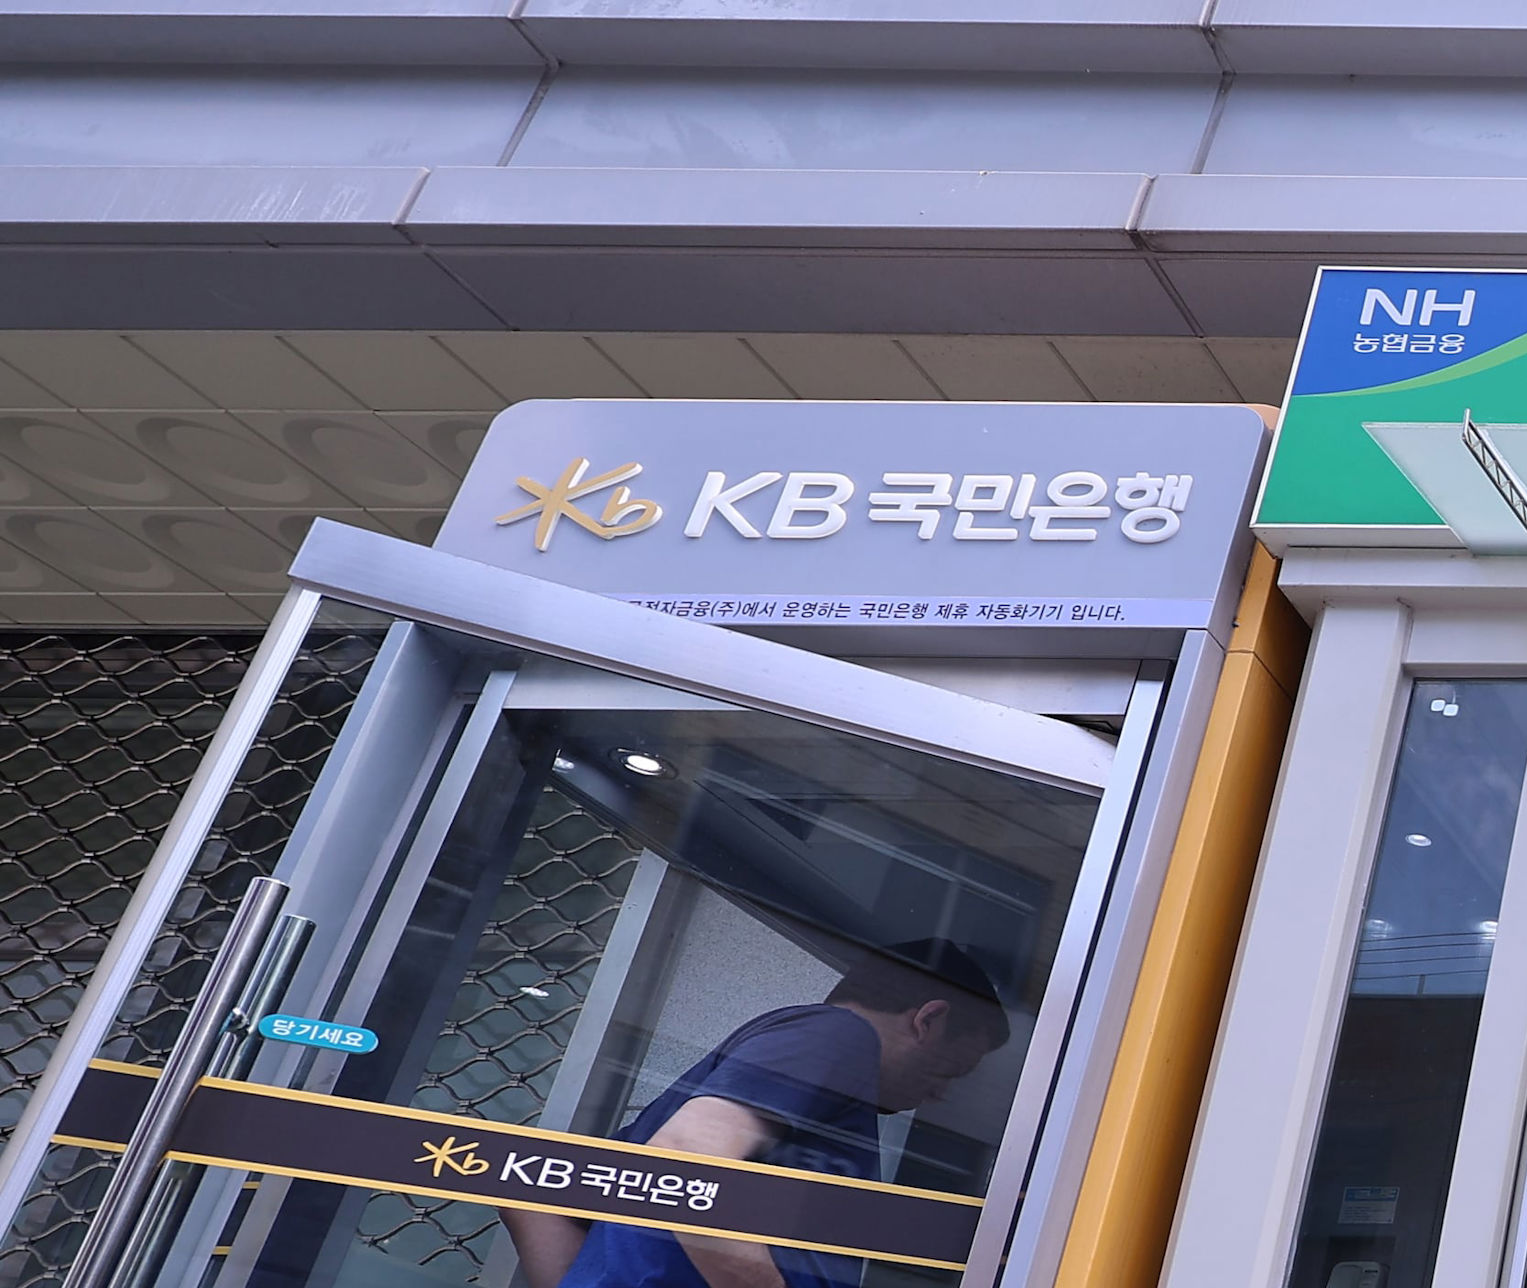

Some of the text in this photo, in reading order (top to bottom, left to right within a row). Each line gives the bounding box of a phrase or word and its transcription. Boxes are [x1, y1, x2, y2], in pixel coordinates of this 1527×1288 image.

[1358, 289, 1476, 327] NH
[1352, 333, 1465, 354] 농협금융
[628, 600, 1125, 621] 전자금융(주)에서 운영하는 국민은행 제휴 자동화기기 입니다.
[272, 1018, 365, 1048] 당기세요
